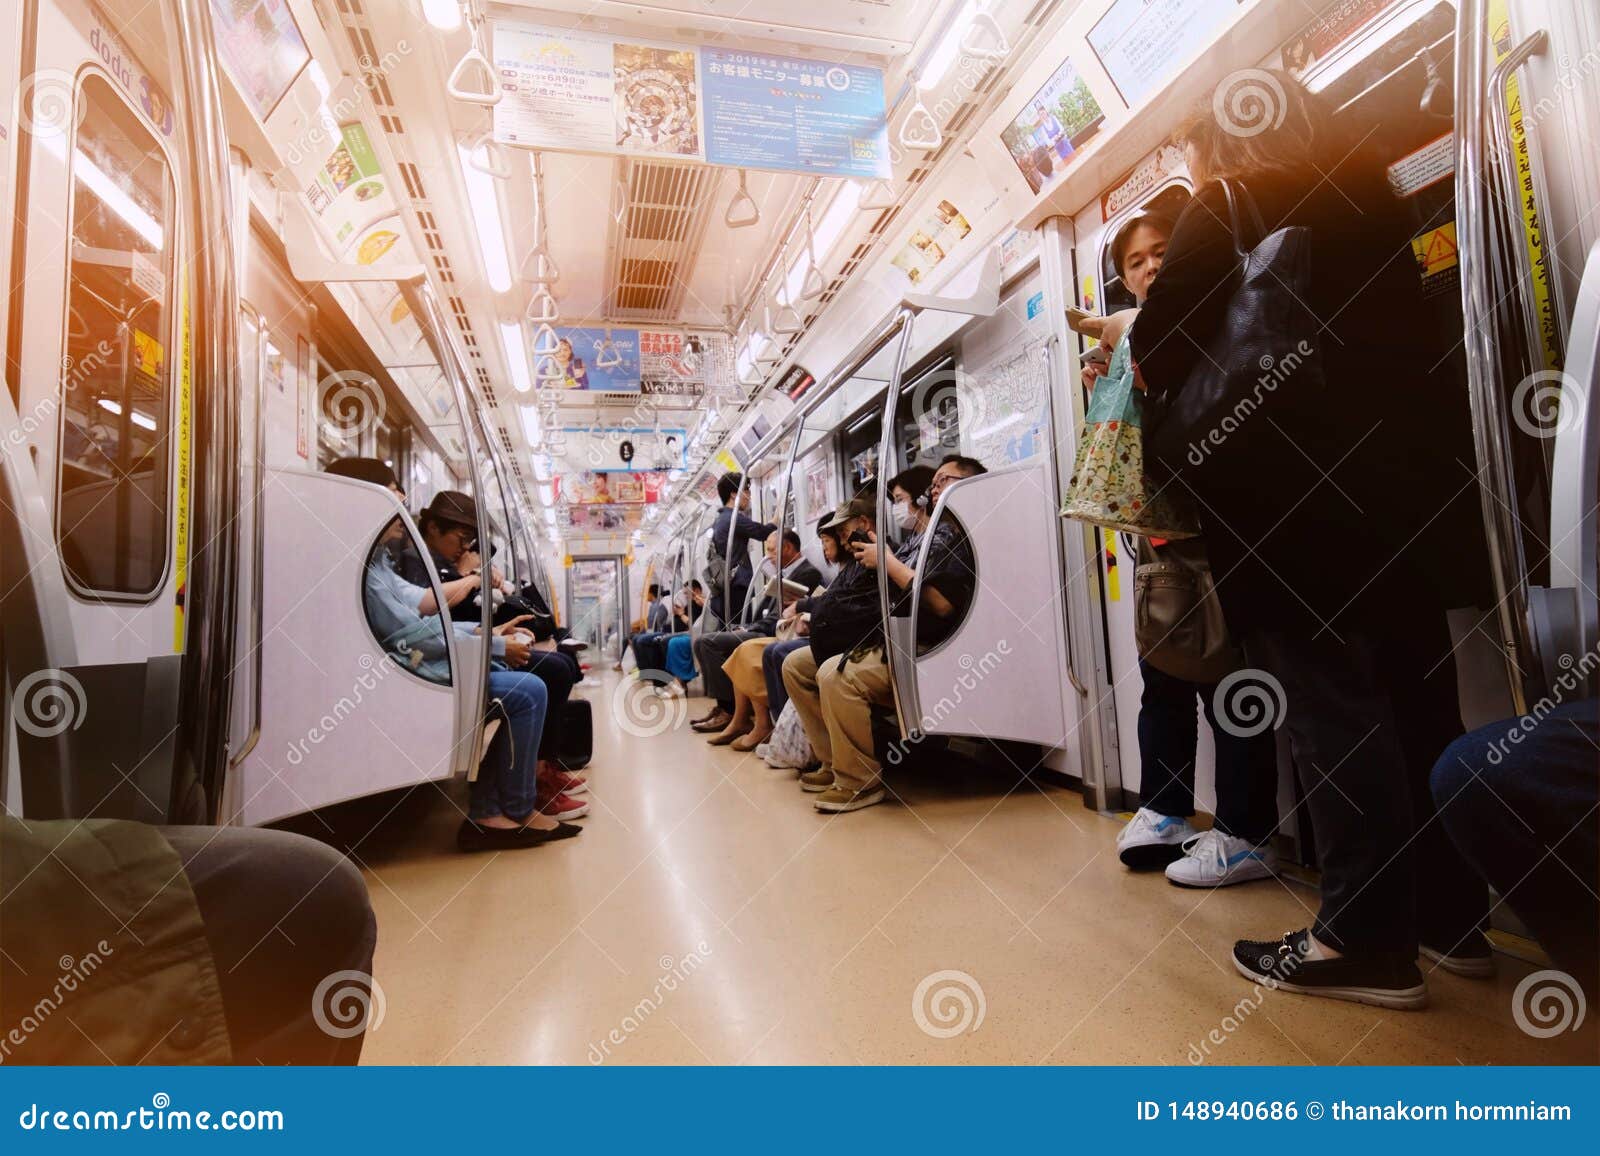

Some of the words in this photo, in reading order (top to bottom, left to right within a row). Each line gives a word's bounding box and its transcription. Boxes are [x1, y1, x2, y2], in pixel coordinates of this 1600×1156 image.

[708, 61, 828, 88] お客様モニター募集
